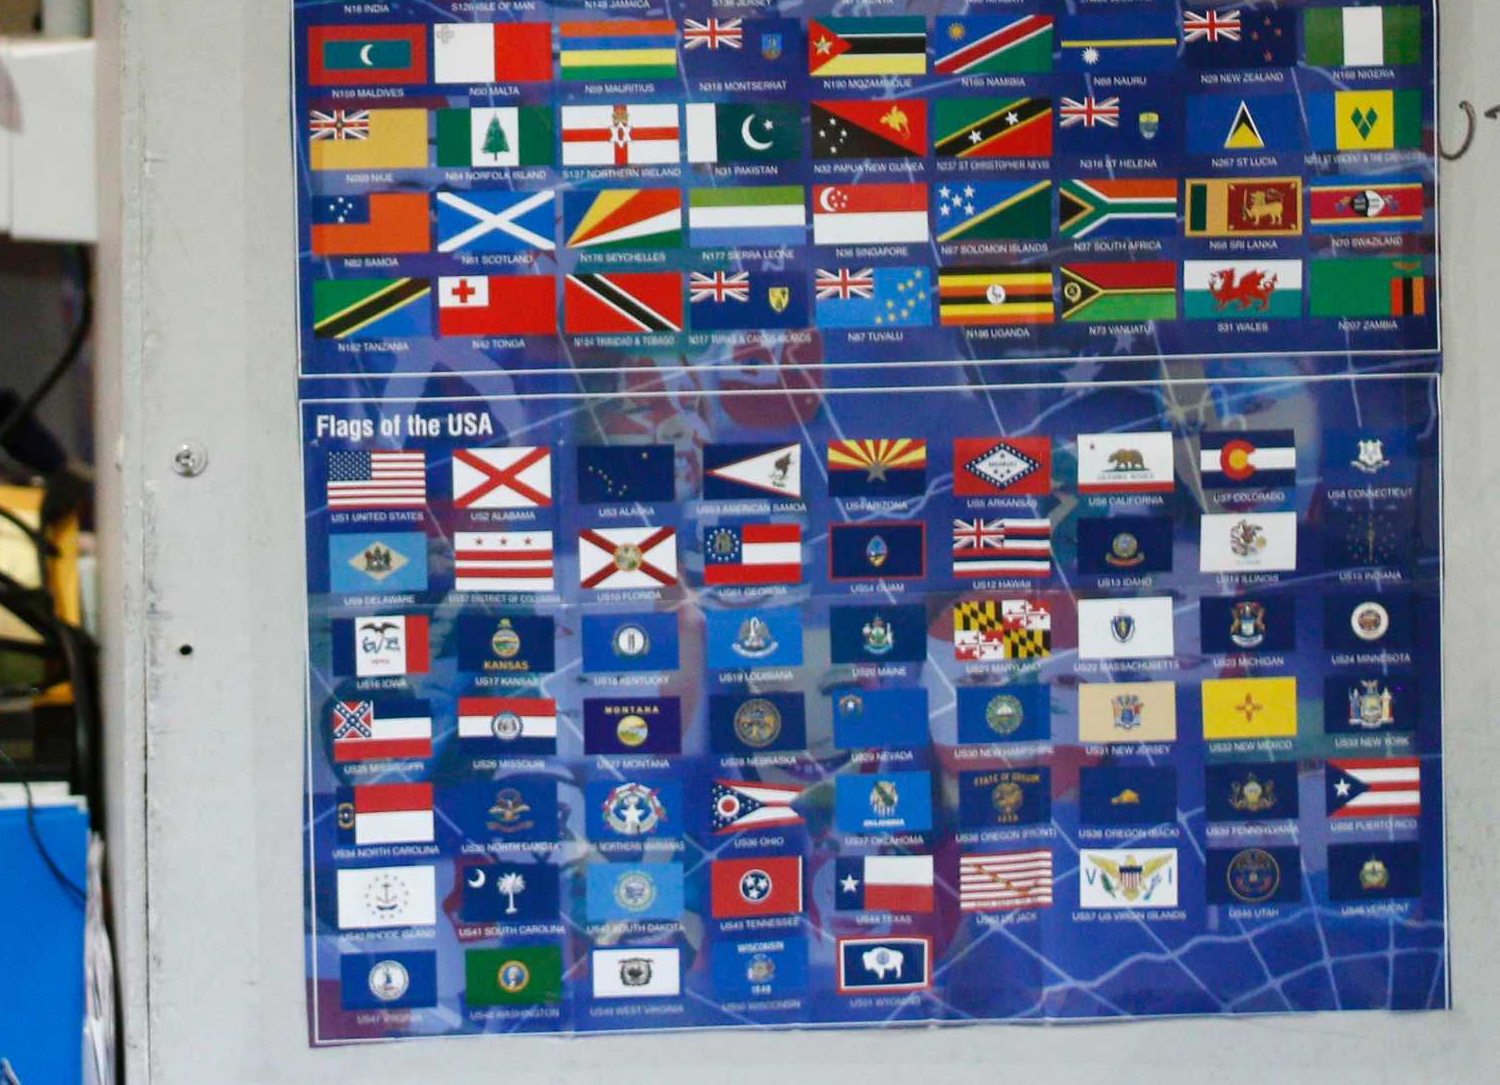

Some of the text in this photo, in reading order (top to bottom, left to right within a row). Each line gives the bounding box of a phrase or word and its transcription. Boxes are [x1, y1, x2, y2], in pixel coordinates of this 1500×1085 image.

[365, 4, 389, 13] INDIA
[609, 0, 649, 8] JAMAICA
[1219, 73, 1283, 83] NEW ZEALAND
[357, 88, 404, 98] MALDIVES
[1105, 159, 1117, 168] ST
[1236, 157, 1276, 167] ST LUCIA
[735, 166, 777, 175] PAKISTAN
[1095, 241, 1161, 251] SOUTH AFRICA
[1247, 240, 1277, 249] LANKA
[1351, 237, 1402, 247] SWAZILAND
[855, 247, 908, 256] SINGAPORE
[365, 257, 398, 266] SAMOA
[480, 255, 532, 264] SCOTLAND
[605, 253, 666, 262] SEYCHELLES
[1108, 324, 1150, 333] VANUATU
[1234, 322, 1267, 332] WALES
[867, 331, 902, 340] TUVALU
[990, 328, 1029, 337] UGANDA
[364, 342, 409, 351] TANZANIA
[491, 339, 525, 348] TONGA
[316, 412, 493, 443] Flags of the USA
[1109, 496, 1163, 505] CALIFORNIA
[352, 512, 387, 521] UNITED
[390, 512, 423, 521] STATES
[492, 511, 535, 520] ALABAMA
[483, 660, 529, 671] KANSAS
[604, 705, 660, 715] MONTANA
[623, 759, 669, 768] MONTANA
[760, 837, 784, 846] OHIO
[357, 847, 439, 857] NORTH CAROLINA
[1253, 908, 1278, 917] UTAH
[745, 919, 799, 928] TENNESSEE
[484, 926, 517, 936] SOUTH
[519, 926, 564, 935] CAROLINA
